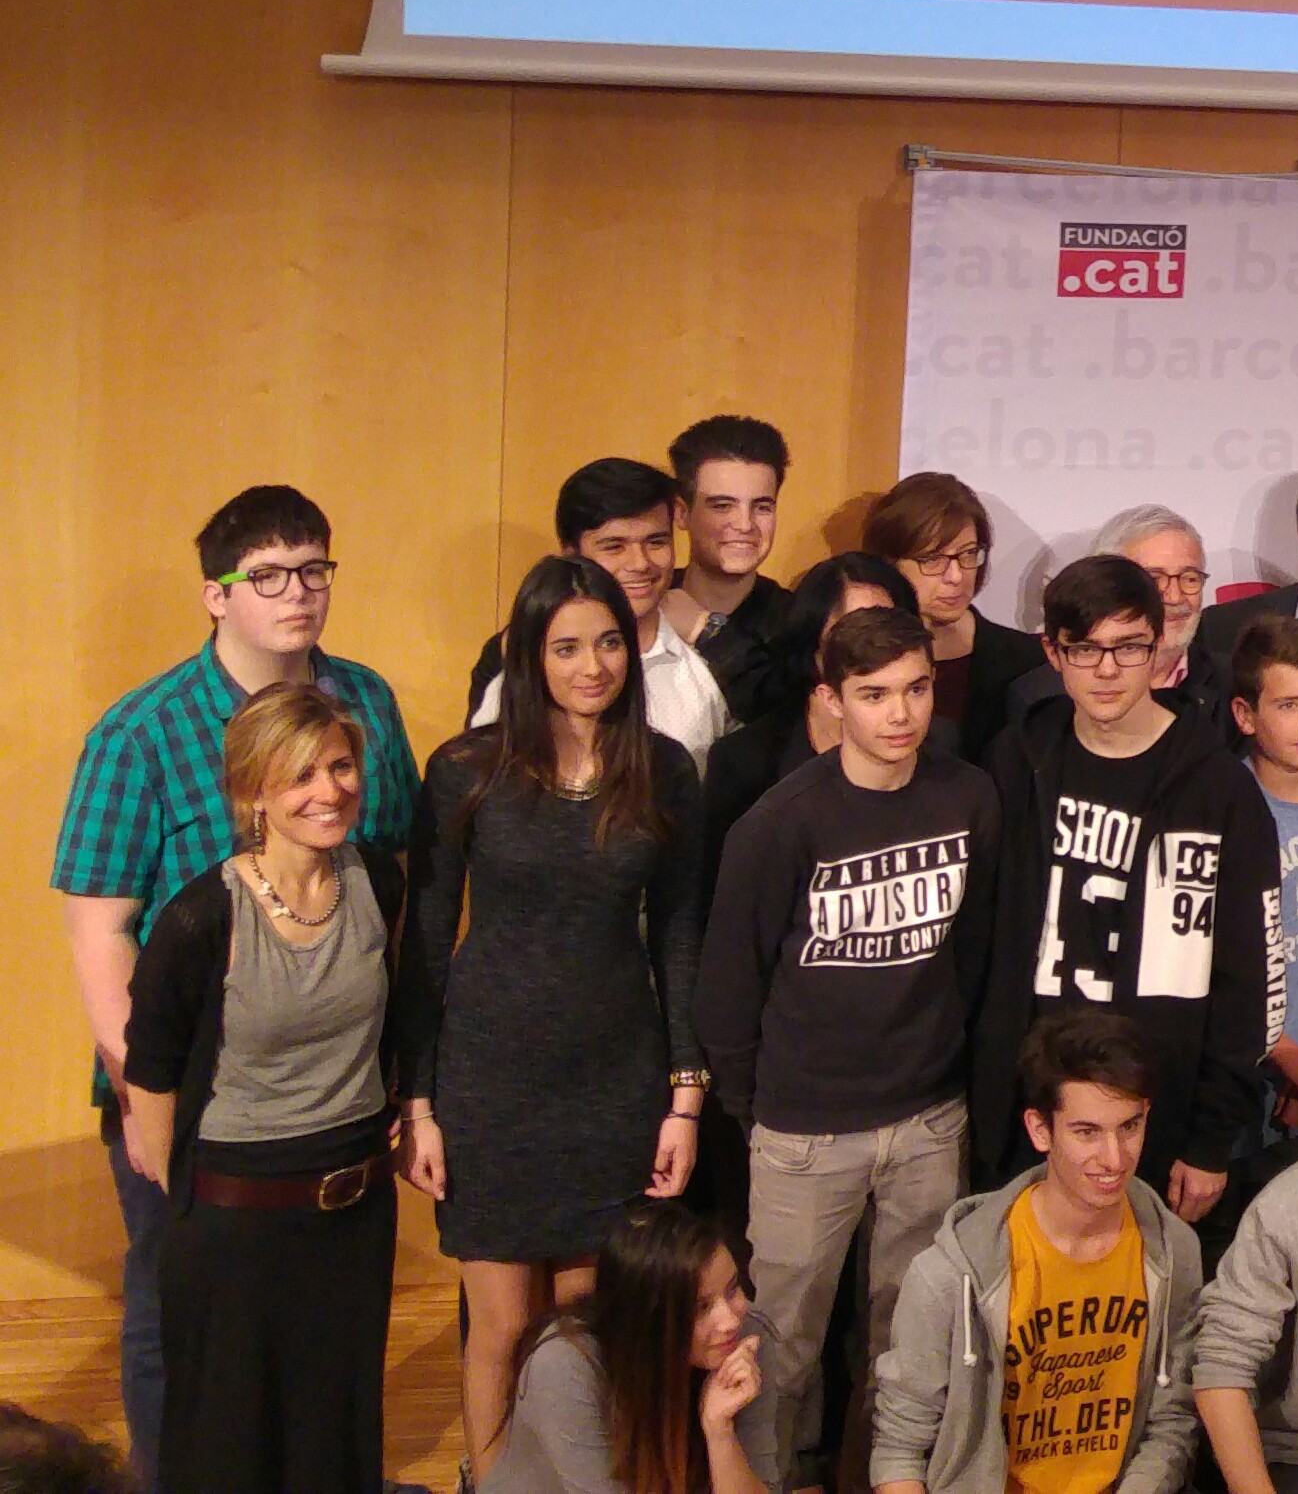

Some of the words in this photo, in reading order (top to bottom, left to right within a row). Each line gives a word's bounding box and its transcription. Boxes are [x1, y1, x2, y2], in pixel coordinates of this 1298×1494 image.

[1064, 226, 1183, 248] FUNDACIÓ
[1063, 252, 1179, 294] .cat
[819, 839, 968, 889] PARENTAL
[1172, 892, 1214, 938] 94
[812, 936, 893, 960] EXPLICIT
[1027, 1343, 1127, 1384] Japanese
[1043, 1370, 1105, 1401] Sport
[1015, 1439, 1063, 1464] TRACK
[1076, 1434, 1119, 1454] FIELD
